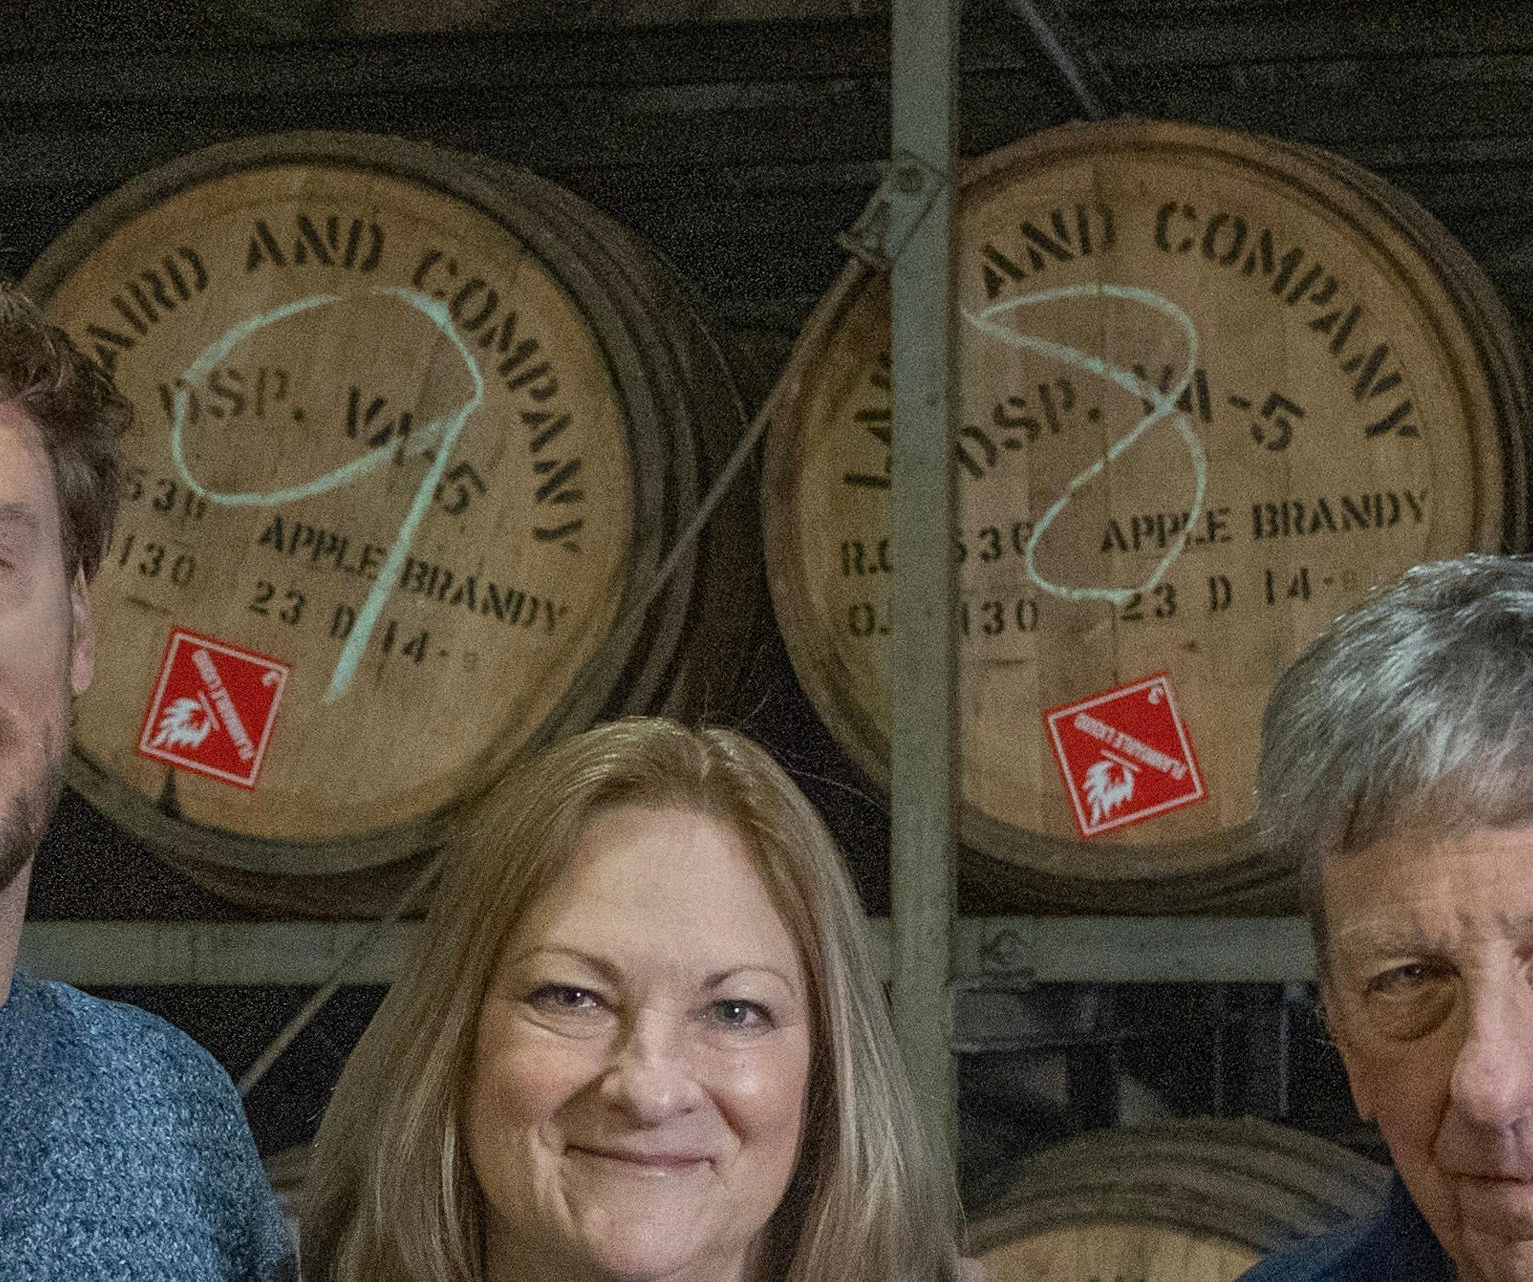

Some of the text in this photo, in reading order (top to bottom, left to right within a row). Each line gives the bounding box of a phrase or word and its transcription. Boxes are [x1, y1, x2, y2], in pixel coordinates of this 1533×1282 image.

[980, 200, 1421, 442] AND COMPANY
[85, 214, 586, 555] AIRD AND COMPANY
[955, 377, 1104, 481] DSP.
[960, 282, 1208, 607] 8
[257, 514, 388, 582] APPLE
[398, 554, 566, 637] BRANDY
[1098, 506, 1233, 556] APPLE
[1250, 488, 1429, 542] BRANDY
[247, 579, 307, 627] 23
[1207, 574, 1234, 613] D
